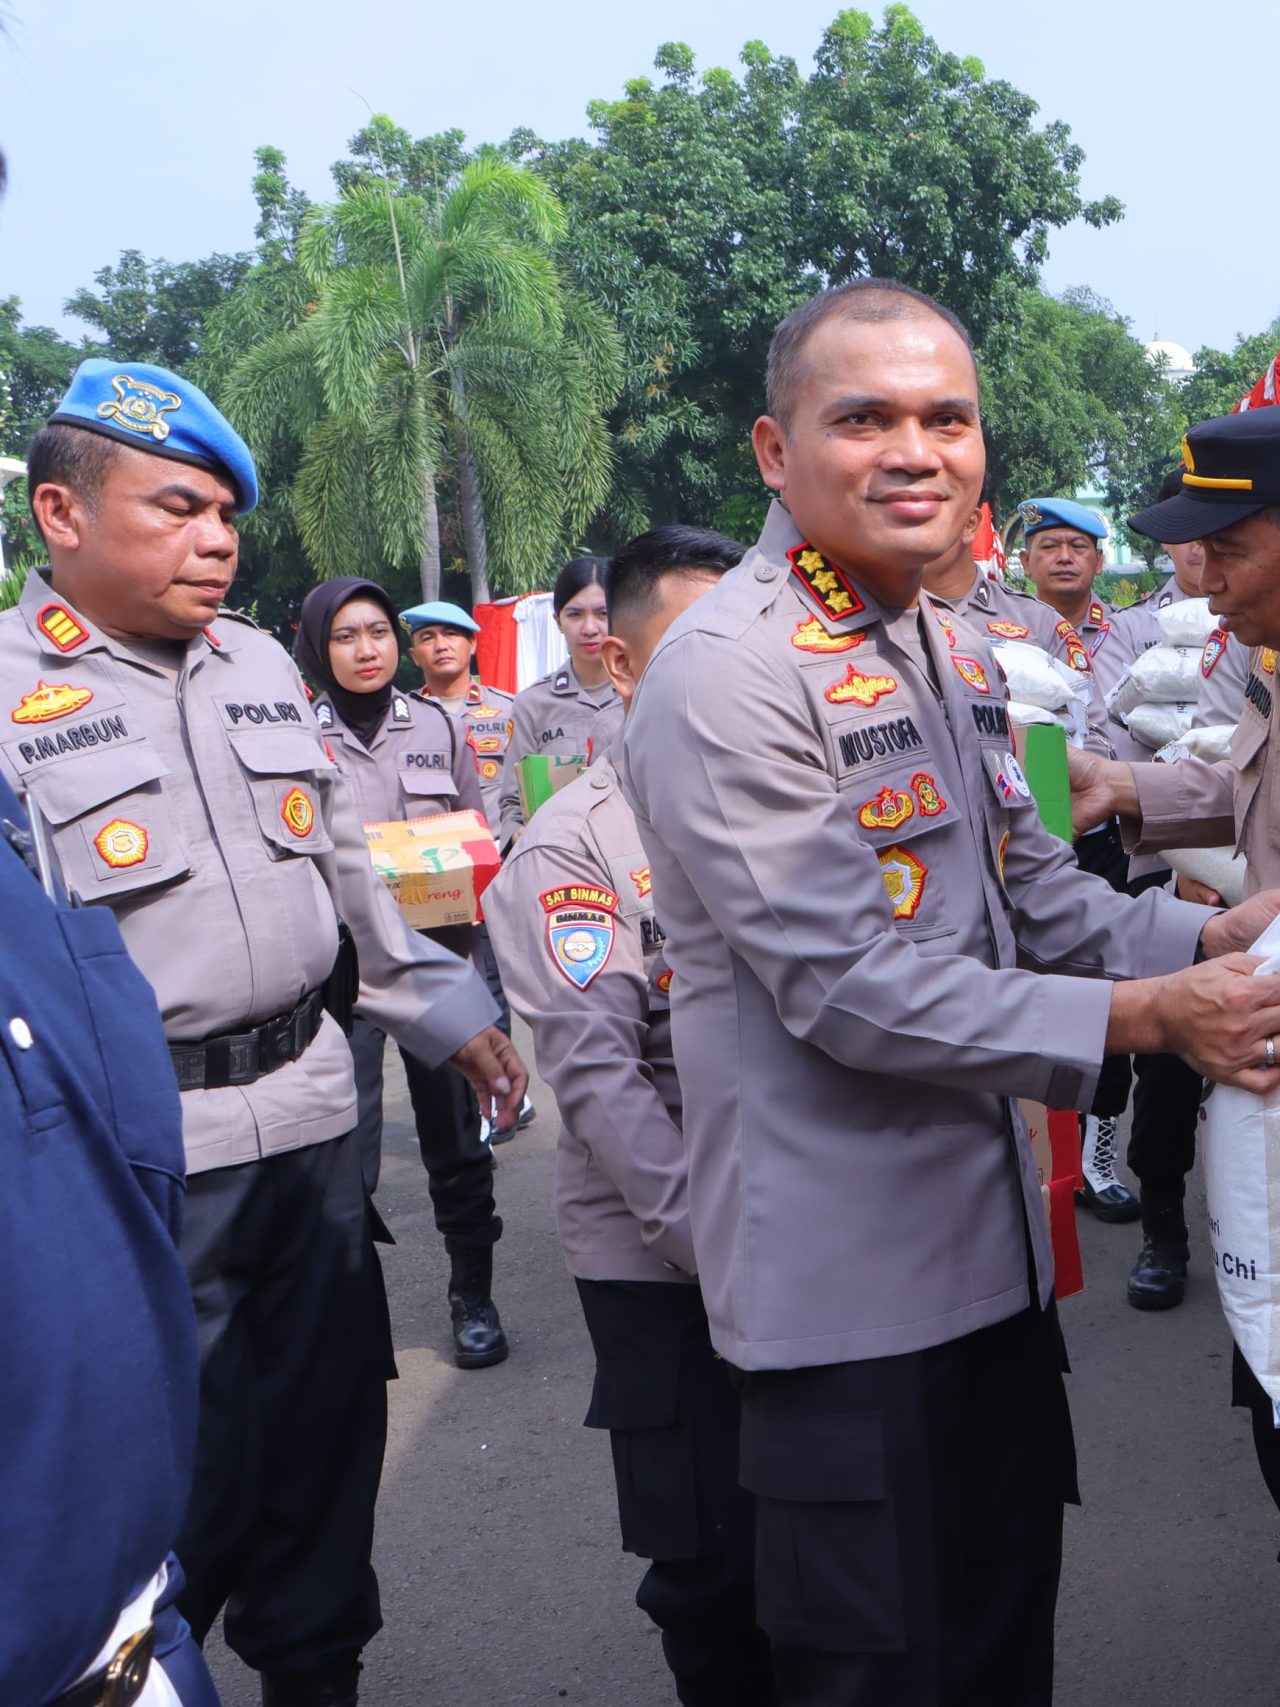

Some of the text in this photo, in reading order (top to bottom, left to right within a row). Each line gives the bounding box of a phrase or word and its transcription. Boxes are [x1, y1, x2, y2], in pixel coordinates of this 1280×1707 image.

[224, 702, 303, 724] POLRI
[469, 721, 506, 734] POLRI
[18, 714, 129, 765] P.MARBUN
[838, 715, 923, 768] MUSTOFA
[406, 753, 446, 770] POLRI
[545, 888, 614, 907] SAT BINMAS
[1223, 1253, 1256, 1280] Chi
